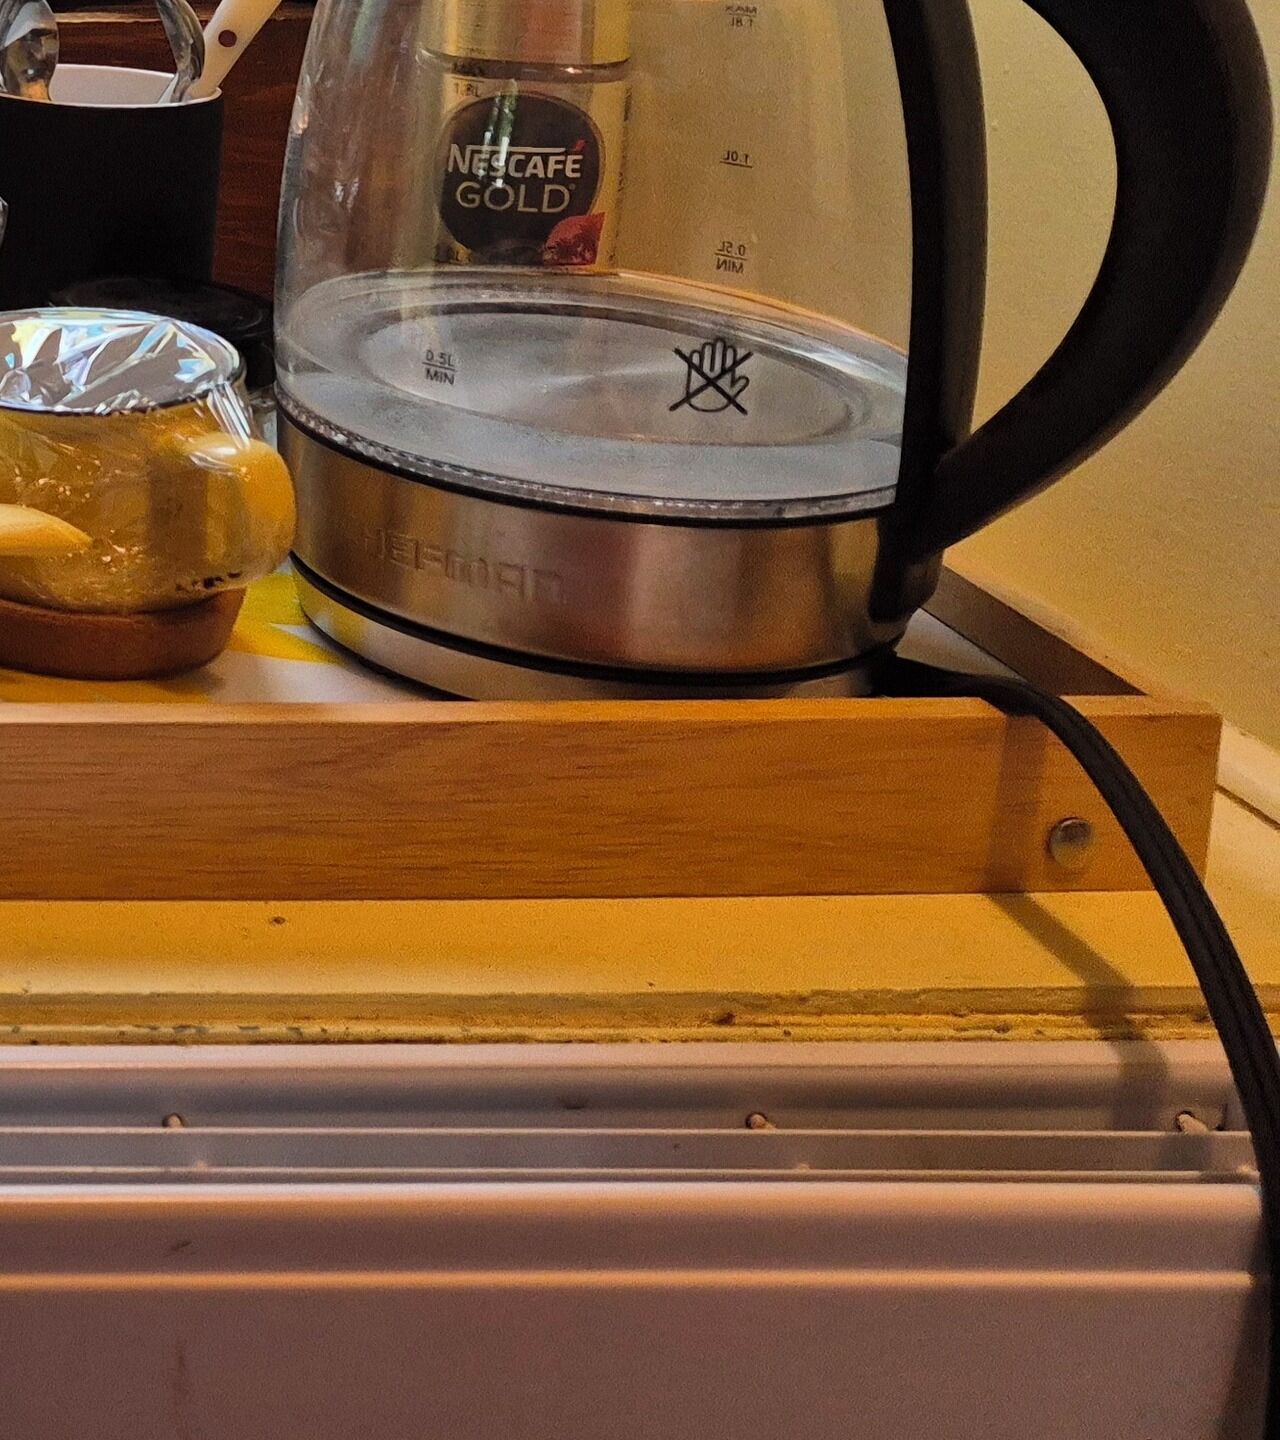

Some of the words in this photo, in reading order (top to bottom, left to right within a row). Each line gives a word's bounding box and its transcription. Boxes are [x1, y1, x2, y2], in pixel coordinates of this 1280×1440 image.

[447, 140, 587, 179] NESCAFÉ
[456, 181, 570, 214] GOLD
[425, 367, 455, 386] MIN
